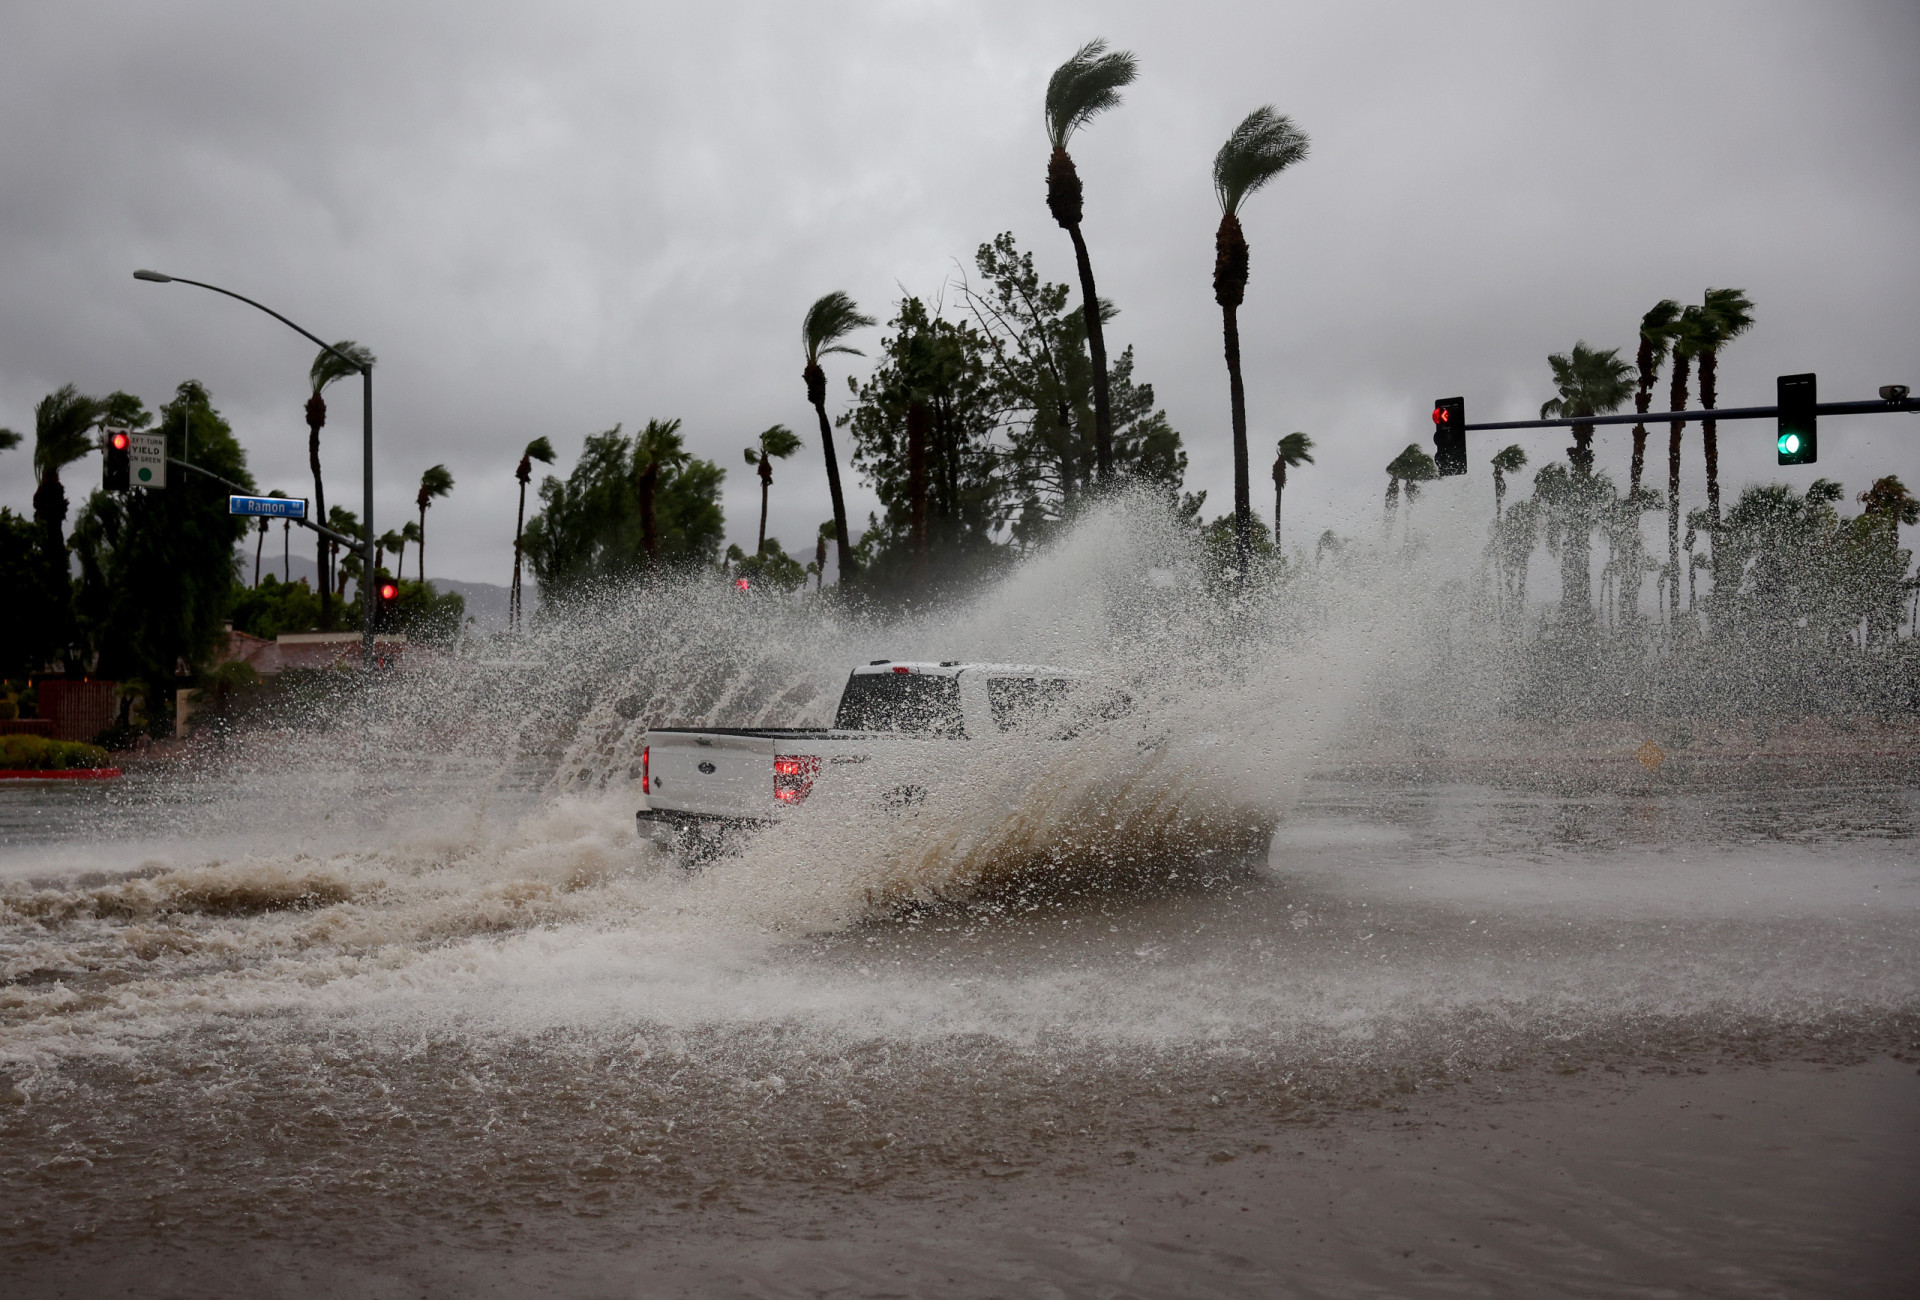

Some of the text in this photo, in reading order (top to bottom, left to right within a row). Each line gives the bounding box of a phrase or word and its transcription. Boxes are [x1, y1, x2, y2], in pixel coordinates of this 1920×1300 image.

[147, 438, 163, 446] TURN
[132, 446, 160, 455] YIELD
[141, 456, 161, 464] GREEN
[248, 500, 285, 513] Ramon
